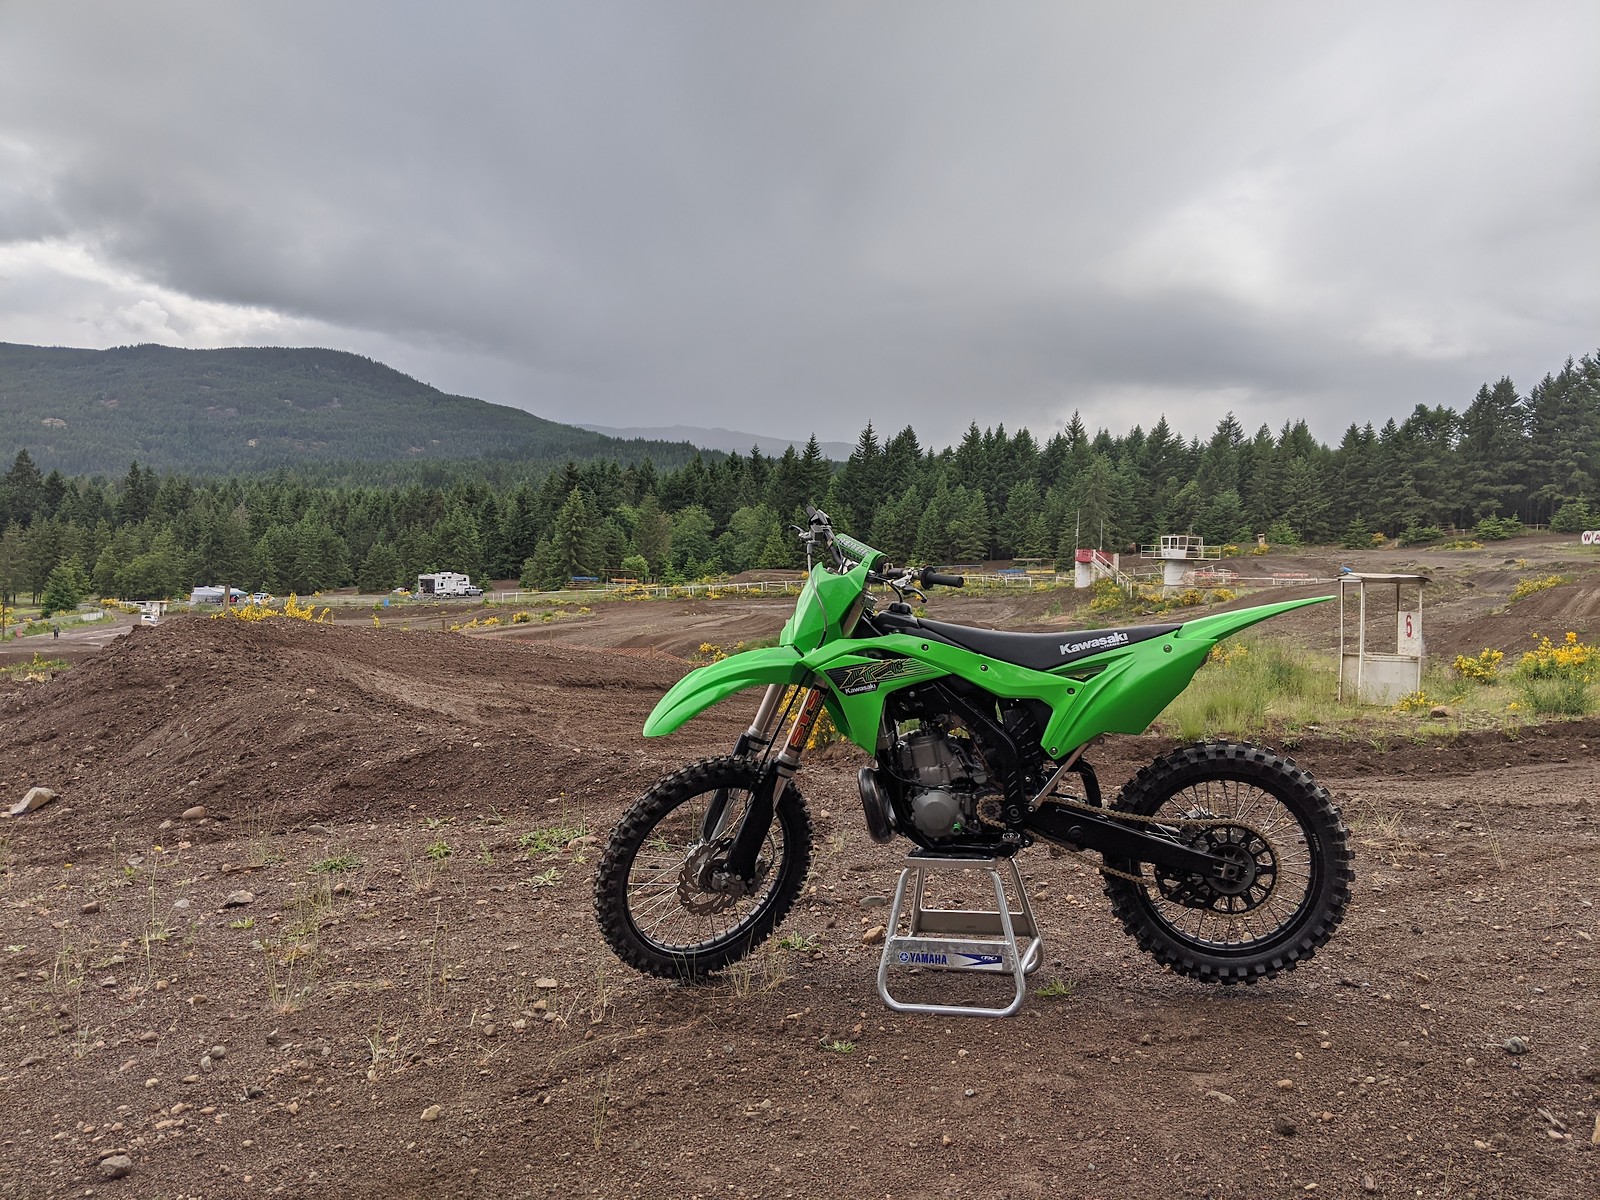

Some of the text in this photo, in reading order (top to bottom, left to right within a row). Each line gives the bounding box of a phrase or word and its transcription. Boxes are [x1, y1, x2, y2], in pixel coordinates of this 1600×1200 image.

[1406, 614, 1412, 638] 6
[1059, 632, 1129, 655] Kawasaki
[845, 683, 877, 694] Kawasaki
[910, 952, 947, 965] YAMAHA
